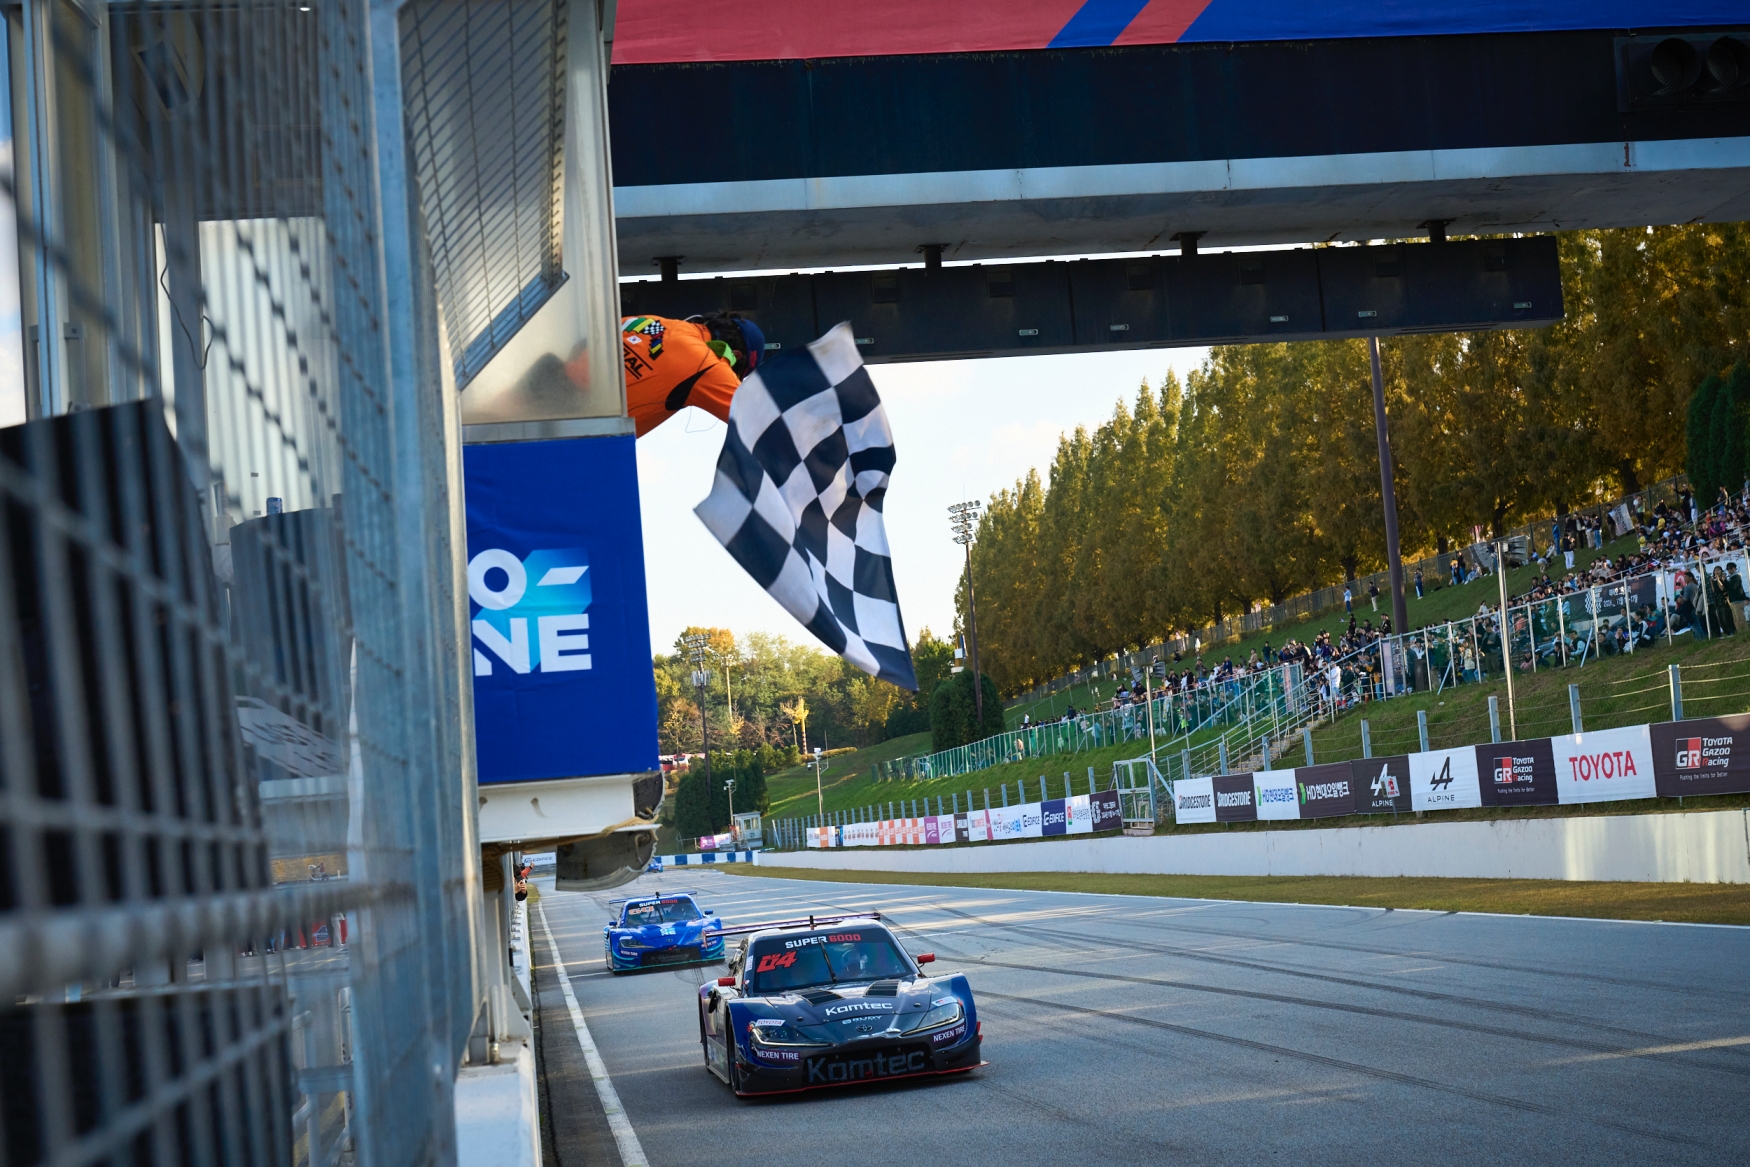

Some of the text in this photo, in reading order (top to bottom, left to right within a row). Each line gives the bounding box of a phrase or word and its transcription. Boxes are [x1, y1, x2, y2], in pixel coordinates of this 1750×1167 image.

[1703, 737, 1733, 746] TOYOTA
[1702, 747, 1730, 756] GAZOO
[1513, 757, 1534, 765] TOYOTA
[1677, 750, 1700, 767] GR
[1702, 757, 1729, 768] Racing
[1569, 751, 1637, 781] TOYOTA
[1494, 767, 1512, 782] GR
[1513, 773, 1533, 783] Racing
[1179, 794, 1211, 809] BRIDGESTONE
[1217, 791, 1251, 807] BRIDGESTONE
[1427, 794, 1455, 802] ALPINE
[785, 934, 861, 948] SUPER 6000
[933, 1030, 955, 1042] NEXEN
[757, 1050, 799, 1060] NEXEN TIRE
